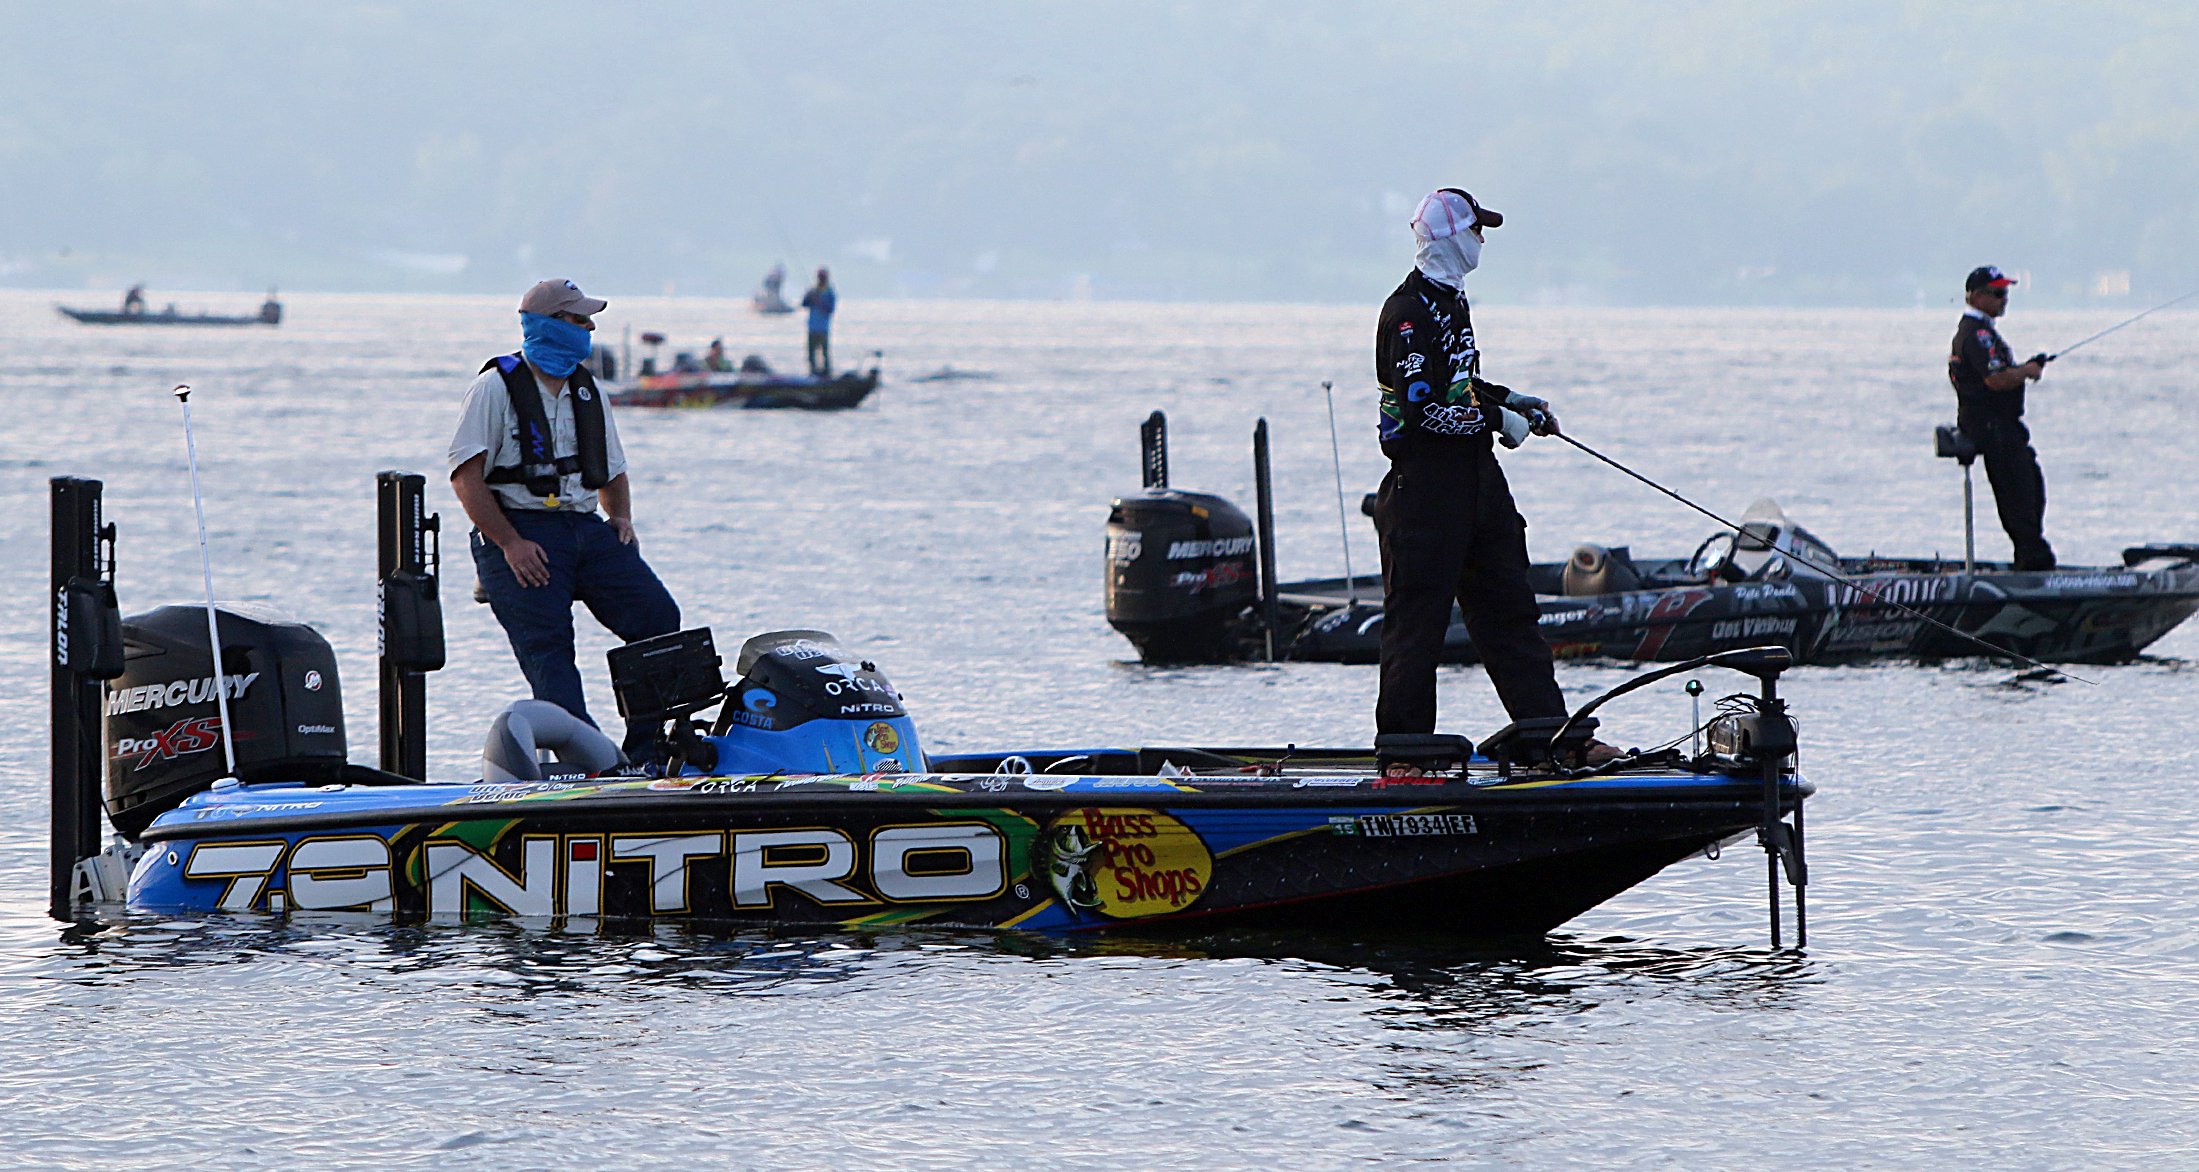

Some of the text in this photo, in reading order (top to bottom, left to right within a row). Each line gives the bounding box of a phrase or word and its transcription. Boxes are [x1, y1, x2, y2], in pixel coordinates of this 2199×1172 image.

[1167, 537, 1253, 560] MERCURY
[57, 590, 69, 666] TALON
[105, 672, 260, 717] MERCURY
[825, 677, 885, 696] ORCA
[840, 703, 895, 714] NITRO
[298, 724, 336, 734] OptiMax
[732, 710, 775, 730] COSTA
[549, 773, 587, 781] NITRO
[701, 780, 757, 794] ORCA
[256, 801, 323, 812] NITRO
[1082, 807, 1157, 841] Bass
[1335, 824, 1355, 835] 15
[1362, 815, 1474, 836] TN 7934 EF
[1104, 838, 1155, 869] Pro
[424, 824, 1008, 916] NITRO
[1115, 866, 1202, 907] Shops
